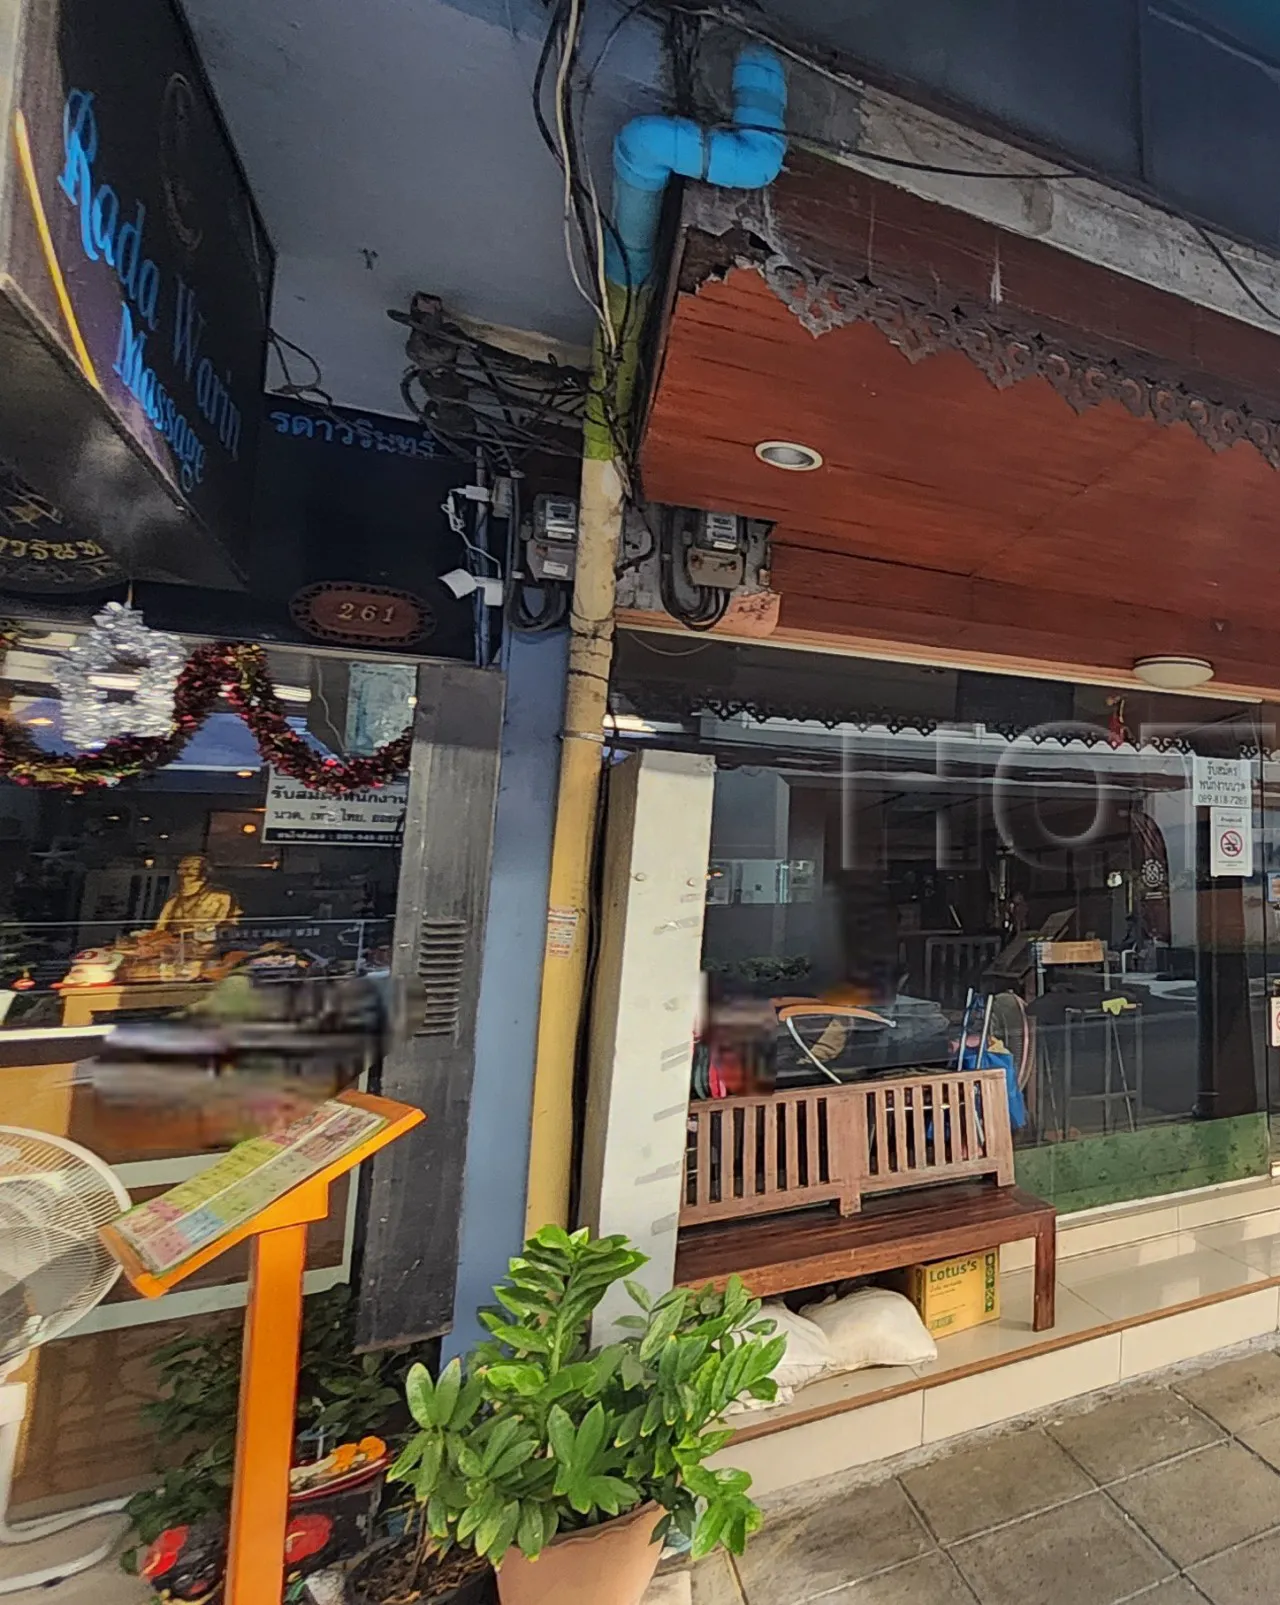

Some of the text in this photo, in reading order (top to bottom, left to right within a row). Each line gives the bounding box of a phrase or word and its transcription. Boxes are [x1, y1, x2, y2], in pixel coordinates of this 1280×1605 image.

[113, 300, 207, 494] Massage
[338, 600, 396, 624] 261
[929, 1260, 977, 1283] Lotus's
